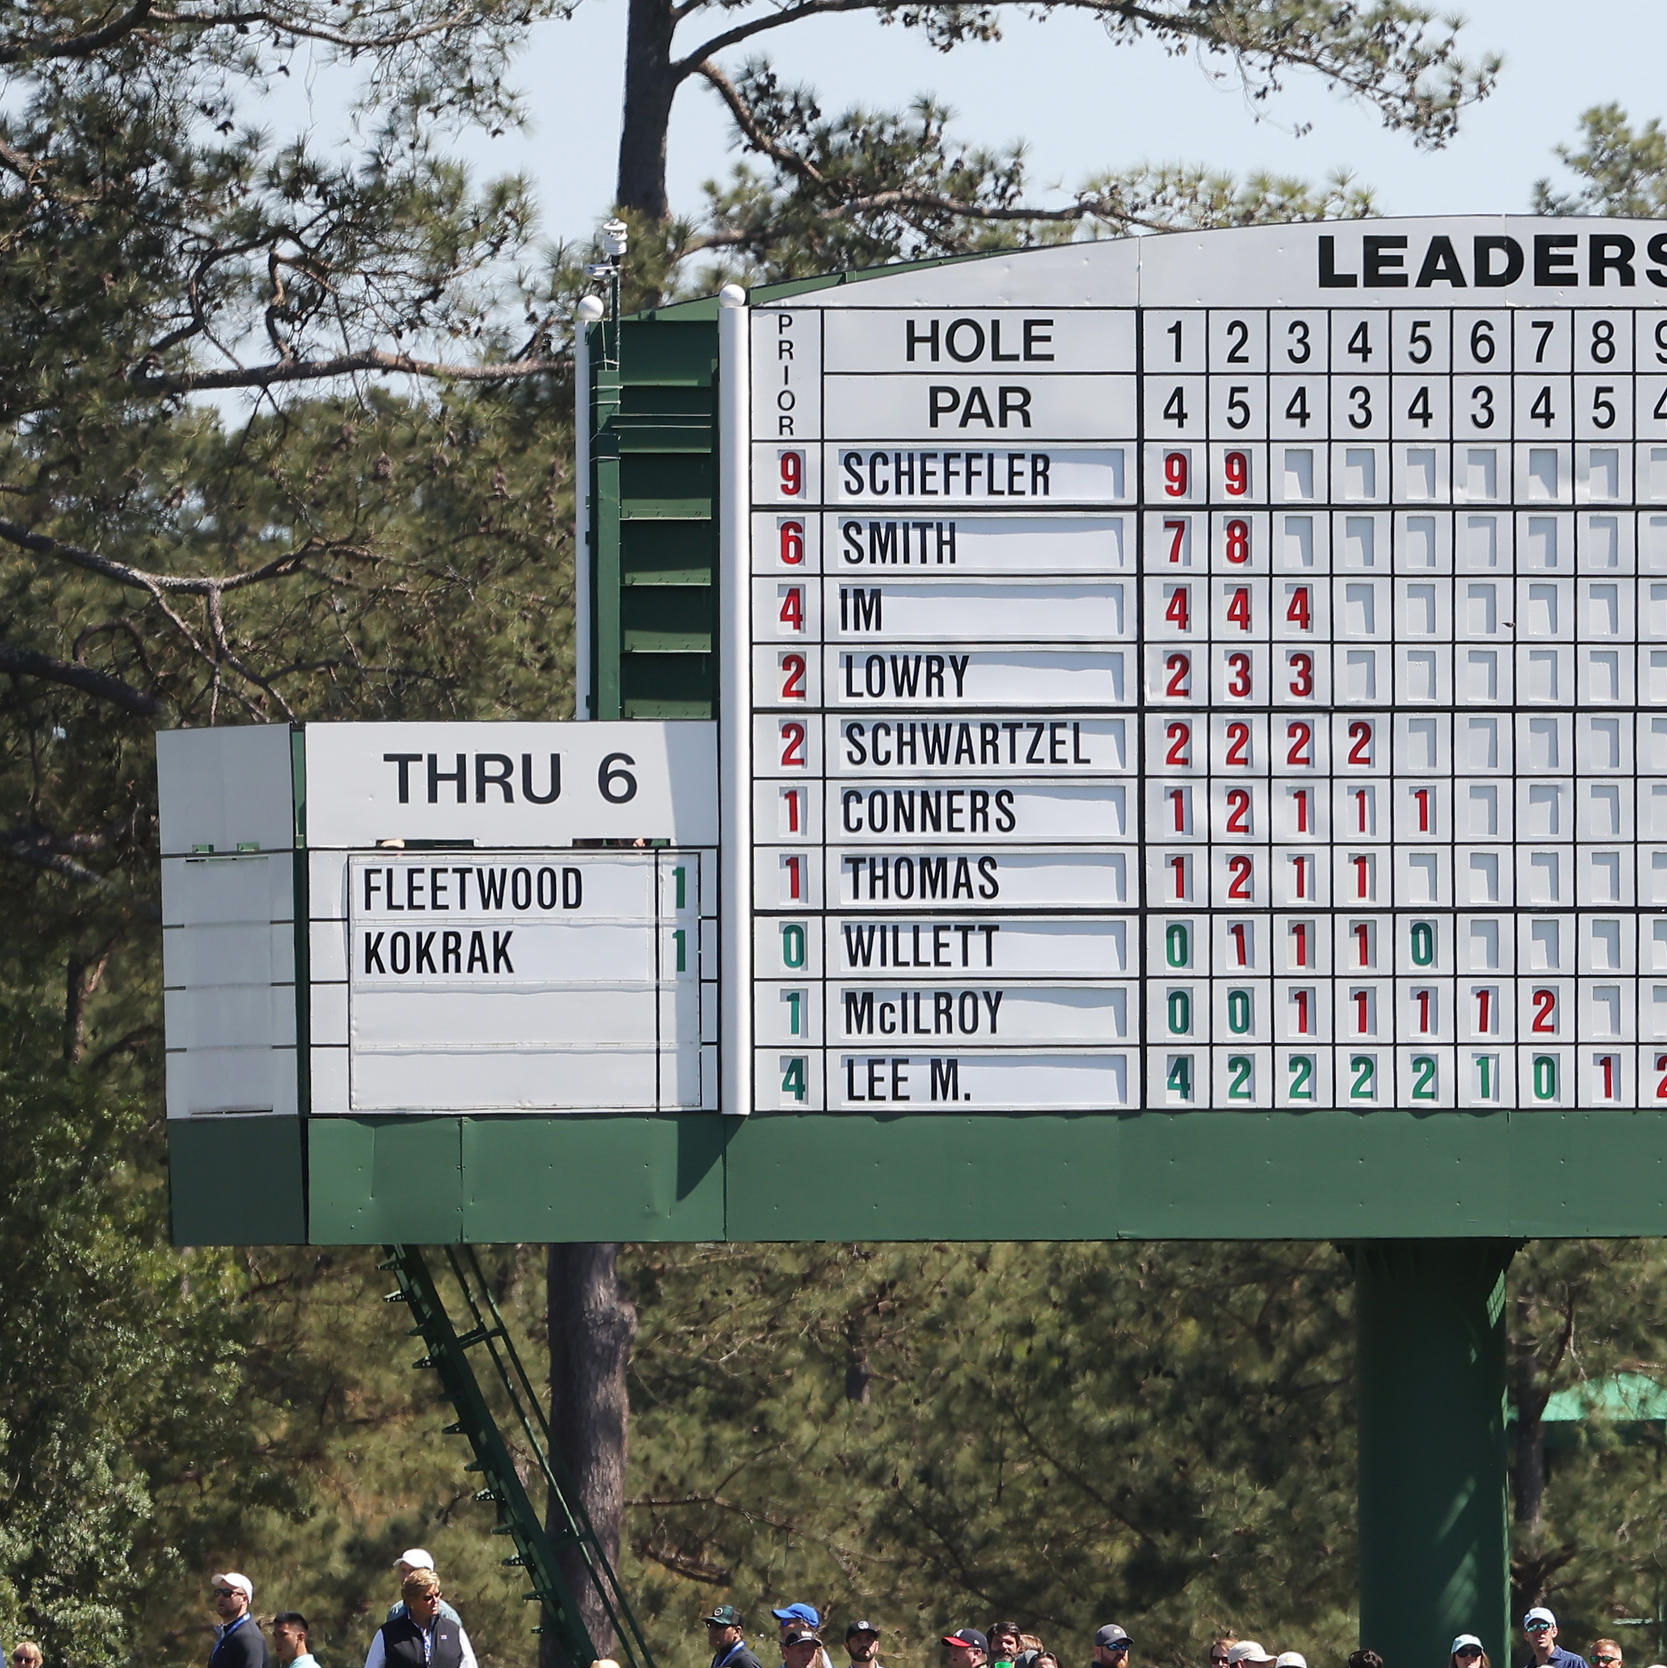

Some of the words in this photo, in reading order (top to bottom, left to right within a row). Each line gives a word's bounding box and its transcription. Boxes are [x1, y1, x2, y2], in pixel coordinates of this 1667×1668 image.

[906, 318, 1055, 363] HOLE
[1167, 320, 1182, 363] 1
[1226, 319, 1249, 364] 2
[1287, 320, 1311, 364] 3
[1347, 321, 1373, 363] 4
[1408, 320, 1432, 365] 5
[1470, 319, 1496, 364] 6
[1531, 320, 1554, 363] 7
[1590, 319, 1616, 364] 8
[777, 313, 796, 436] PRIOR
[929, 385, 1032, 428] PAR
[1163, 386, 1188, 429] 4
[1226, 386, 1251, 430] 5
[1285, 386, 1311, 428] 4
[1348, 385, 1373, 430] 3
[1407, 386, 1433, 429] 4
[1470, 385, 1495, 430] 3
[1530, 386, 1556, 428] 4
[1592, 386, 1616, 430] 5
[780, 451, 801, 496] 9
[843, 451, 1051, 496] SCHEFFLER
[1164, 452, 1188, 497] 9
[1224, 451, 1248, 497] 9
[780, 520, 803, 565] 6
[842, 520, 956, 565] SMITH
[1164, 520, 1186, 563] 7
[1226, 519, 1249, 565] 8
[780, 587, 804, 631] 4
[840, 588, 882, 632] IM
[1165, 587, 1189, 631] 4
[1227, 587, 1252, 631] 4
[1287, 587, 1311, 630] 4
[782, 654, 806, 699] 2
[845, 654, 970, 698] LOWRY
[1166, 653, 1190, 697] 2
[1228, 652, 1252, 698] 3
[1289, 652, 1313, 697] 3
[781, 722, 805, 766] 2
[845, 721, 1091, 766] SCHWARTZEL
[1166, 722, 1190, 766] 2
[1226, 722, 1250, 766] 2
[1287, 721, 1311, 766] 2
[1348, 721, 1372, 765] 2
[383, 753, 561, 805] THRU
[598, 752, 638, 804] 6
[784, 790, 799, 833] 1
[841, 789, 1016, 833] CONNERS
[1169, 789, 1184, 832] 1
[1226, 788, 1250, 833] 2
[1293, 789, 1307, 833] 1
[1355, 789, 1366, 833] 1
[1414, 789, 1429, 833] 1
[364, 866, 583, 911] FLEETWOOD
[671, 865, 686, 910] 1
[785, 856, 800, 900] 1
[844, 856, 1000, 900] THOMAS
[1170, 856, 1185, 899] 1
[1228, 855, 1252, 900] 2
[1292, 856, 1305, 899] 1
[1353, 855, 1367, 899] 1
[364, 930, 514, 975] KOKRAK
[672, 927, 687, 972] 1
[782, 924, 805, 969] 0
[843, 924, 1000, 967] WILLETT
[1165, 923, 1189, 968] 0
[1230, 923, 1247, 966] 1
[1291, 924, 1307, 967] 1
[1354, 923, 1368, 967] 1
[1411, 922, 1434, 966] 0
[786, 991, 801, 1035] 1
[844, 990, 1004, 1035] McILROY
[1168, 990, 1190, 1034] 0
[1228, 990, 1251, 1034] 0
[1294, 990, 1308, 1034] 1
[1353, 991, 1368, 1034] 1
[1416, 990, 1429, 1033] 1
[1476, 989, 1490, 1033] 1
[1532, 989, 1556, 1033] 2
[781, 1058, 806, 1101] 4
[847, 1058, 911, 1102] LEE
[930, 1058, 971, 1101] M.
[1167, 1054, 1191, 1100] 4
[1228, 1055, 1252, 1099] 2
[1288, 1055, 1313, 1099] 2
[1350, 1055, 1375, 1099] 2
[1412, 1055, 1436, 1100] 2
[1475, 1055, 1491, 1099] 1
[1533, 1055, 1556, 1100] 0
[1599, 1056, 1613, 1099] 1
